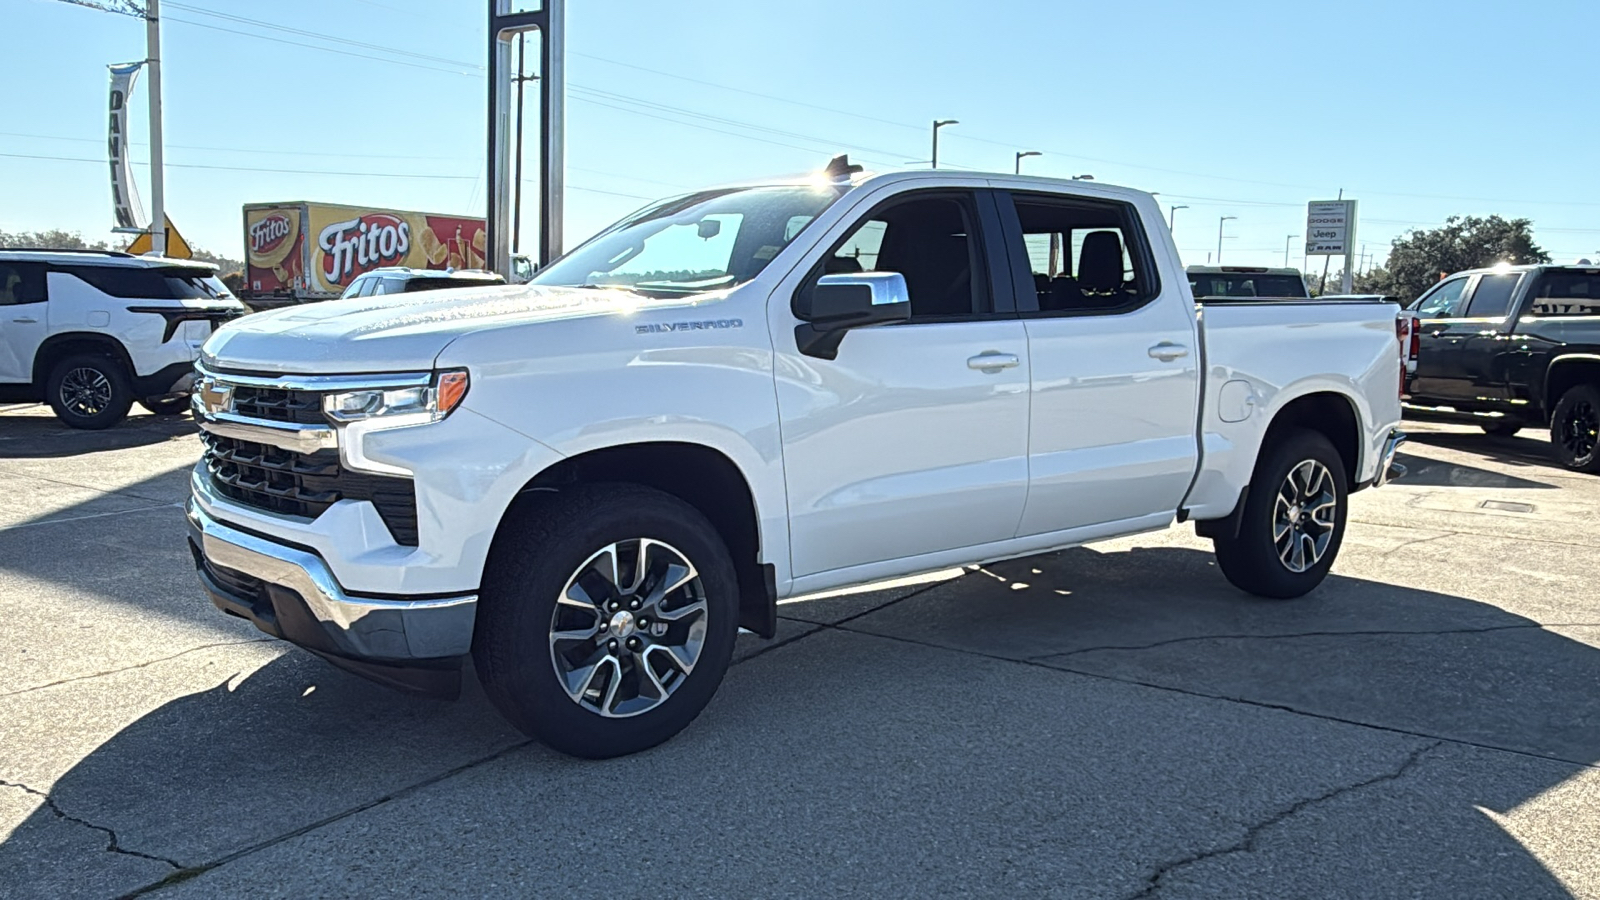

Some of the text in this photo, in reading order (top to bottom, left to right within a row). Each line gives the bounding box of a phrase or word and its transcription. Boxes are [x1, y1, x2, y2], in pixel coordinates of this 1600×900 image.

[109, 90, 133, 227] DANTIN
[250, 217, 290, 251] Fritos
[319, 216, 410, 284] Fritos
[1313, 230, 1337, 239] Jeep
[635, 319, 743, 334] SILVERADO
